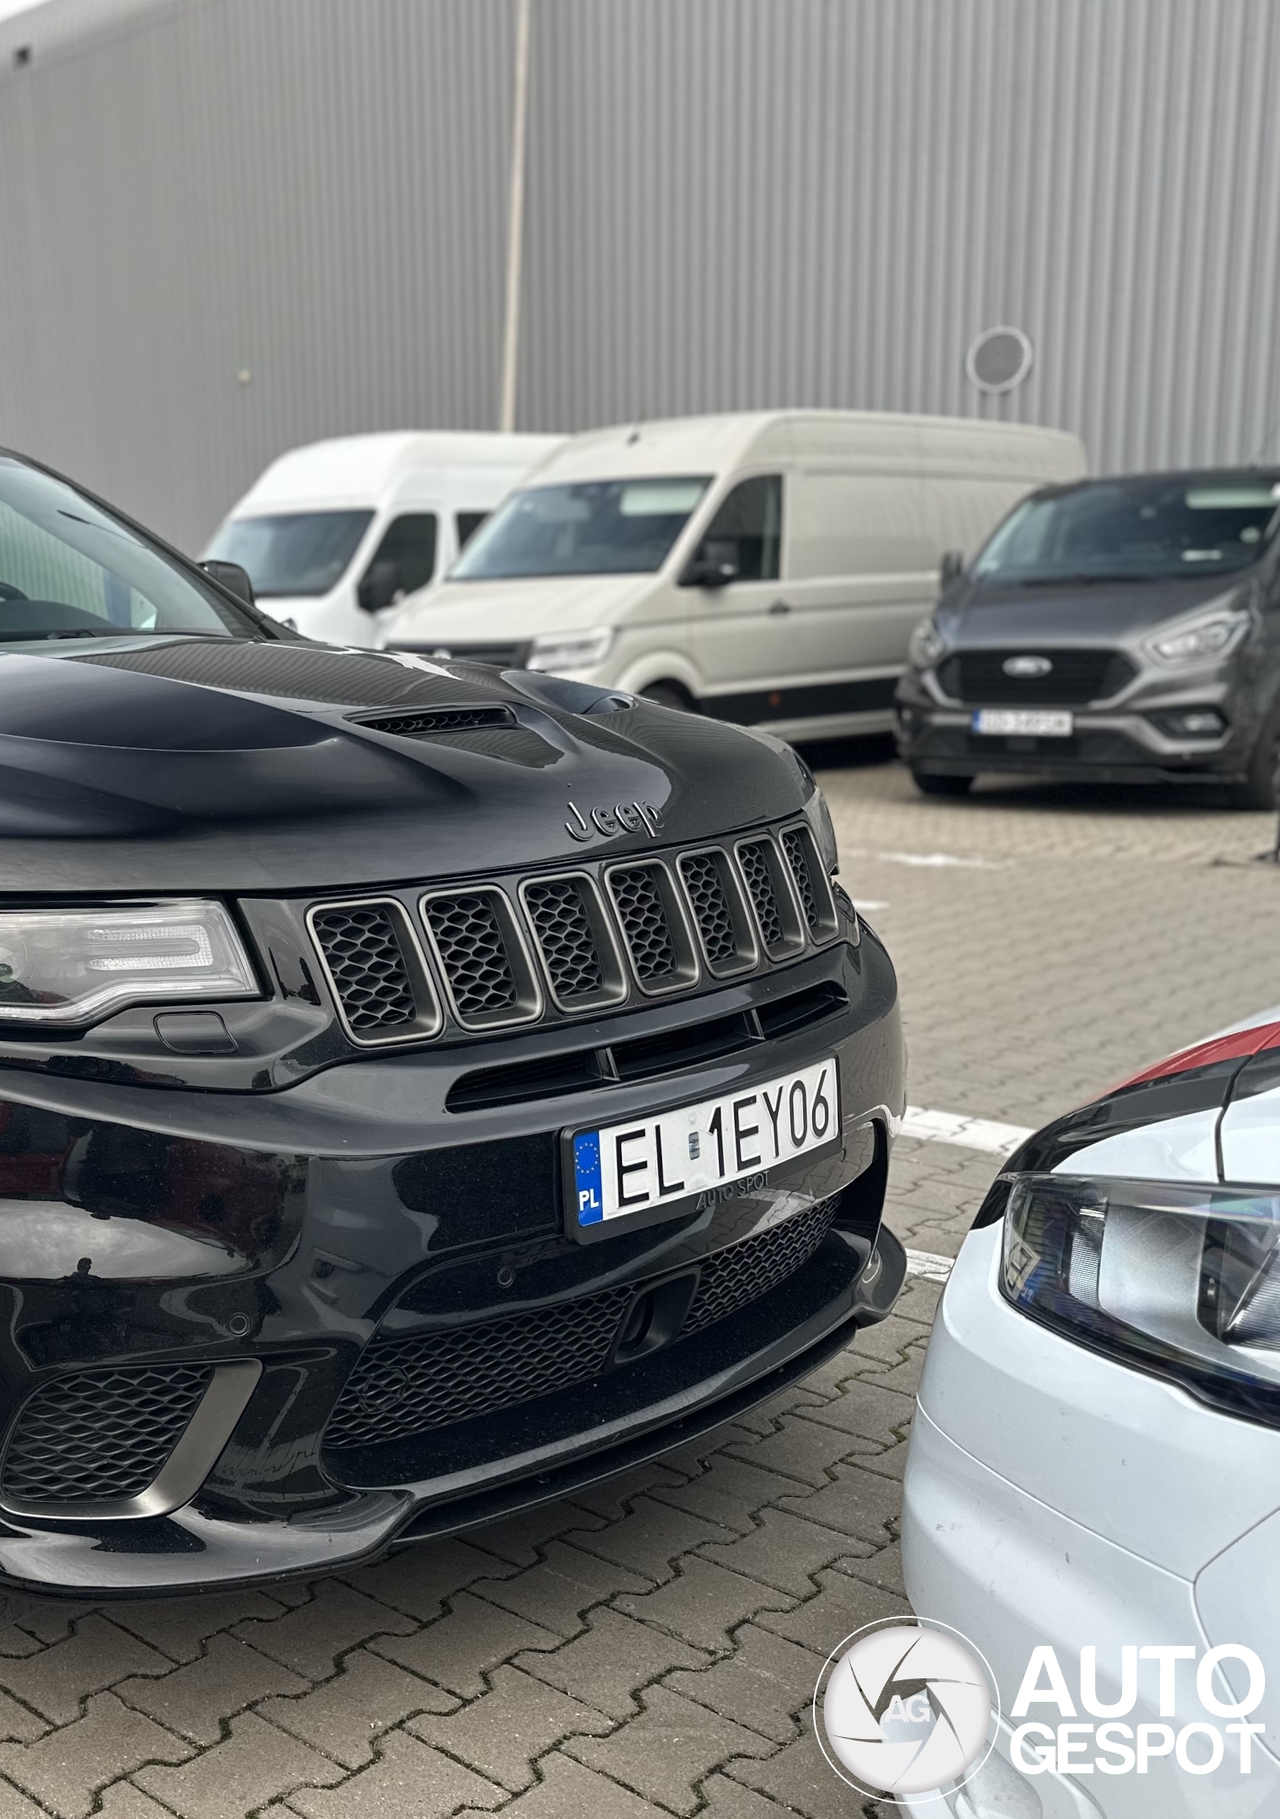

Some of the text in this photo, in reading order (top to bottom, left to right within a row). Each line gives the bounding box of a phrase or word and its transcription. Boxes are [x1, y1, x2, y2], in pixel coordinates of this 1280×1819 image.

[564, 800, 666, 842] Jeep
[616, 1068, 830, 1208] EL 1EY06
[578, 1188, 600, 1212] PL
[695, 1170, 770, 1211] AUTO SPOT
